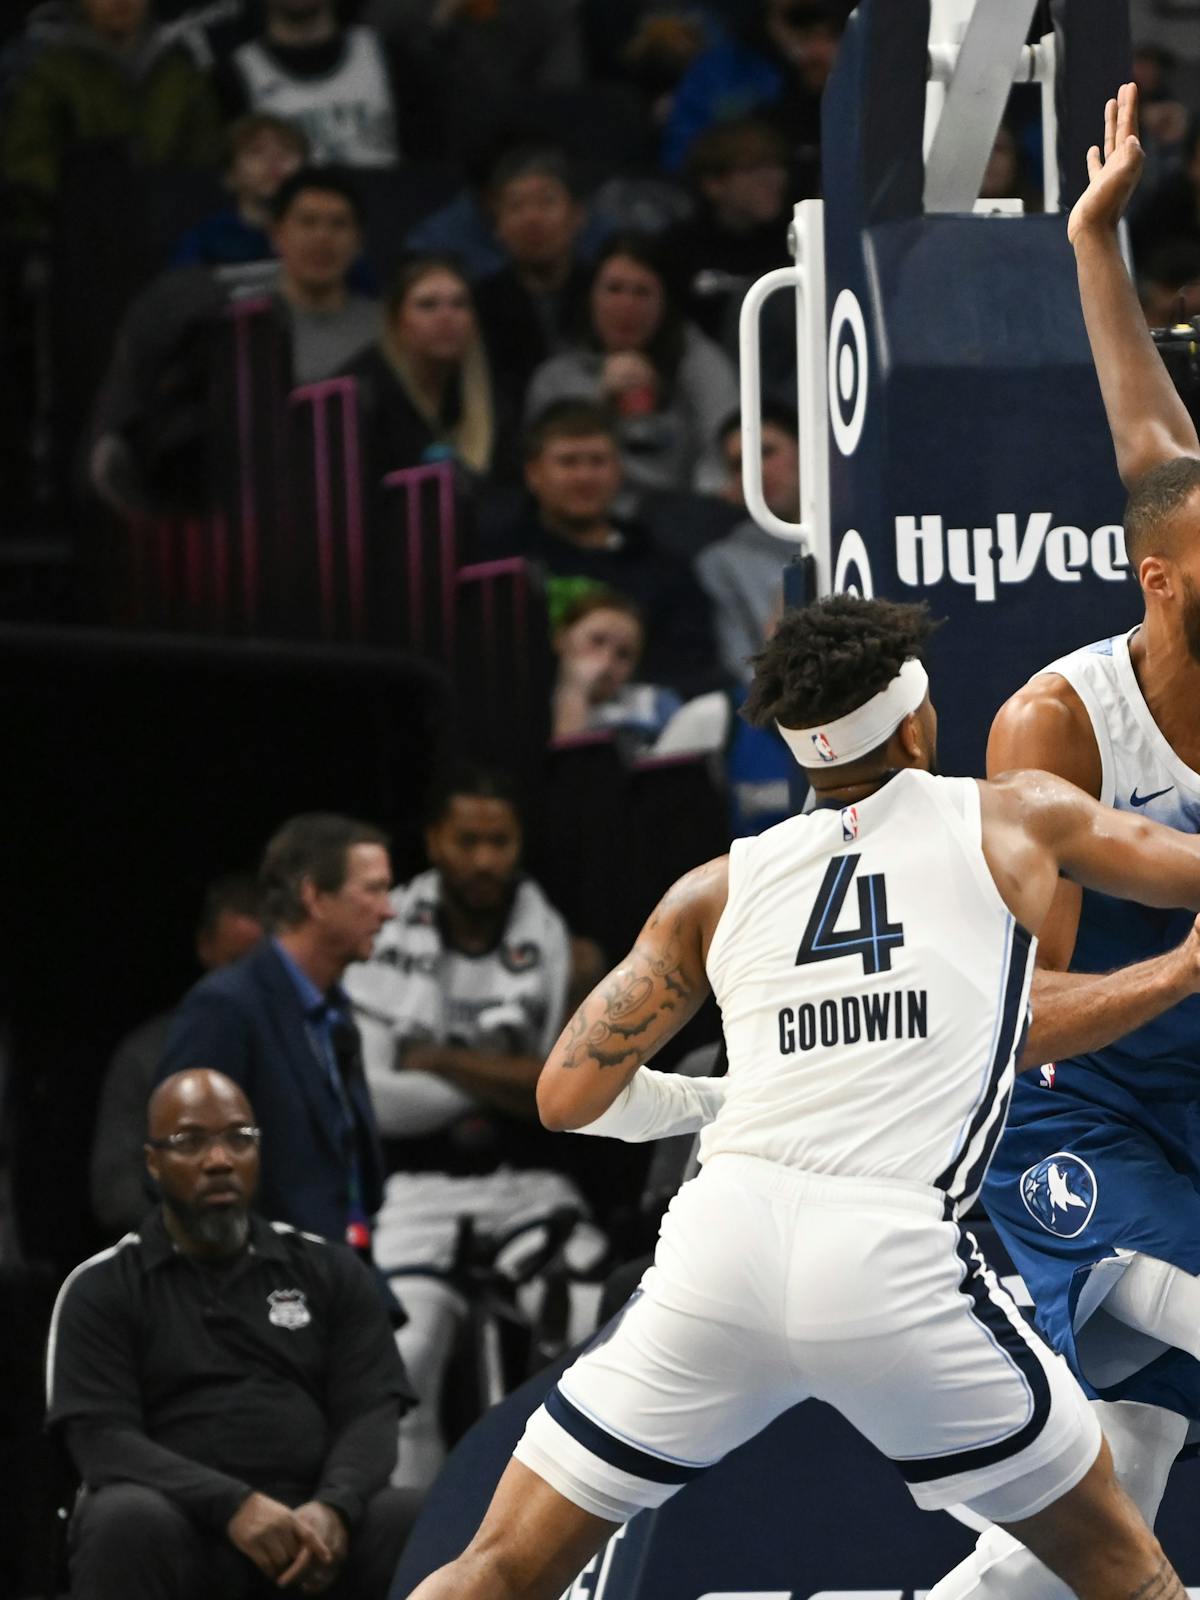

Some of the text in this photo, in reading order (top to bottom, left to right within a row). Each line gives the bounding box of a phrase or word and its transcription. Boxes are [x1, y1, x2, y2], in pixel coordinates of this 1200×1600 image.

[895, 512, 1129, 602] HyVee
[795, 853, 905, 975] 4
[778, 990, 928, 1055] GOODWIN
